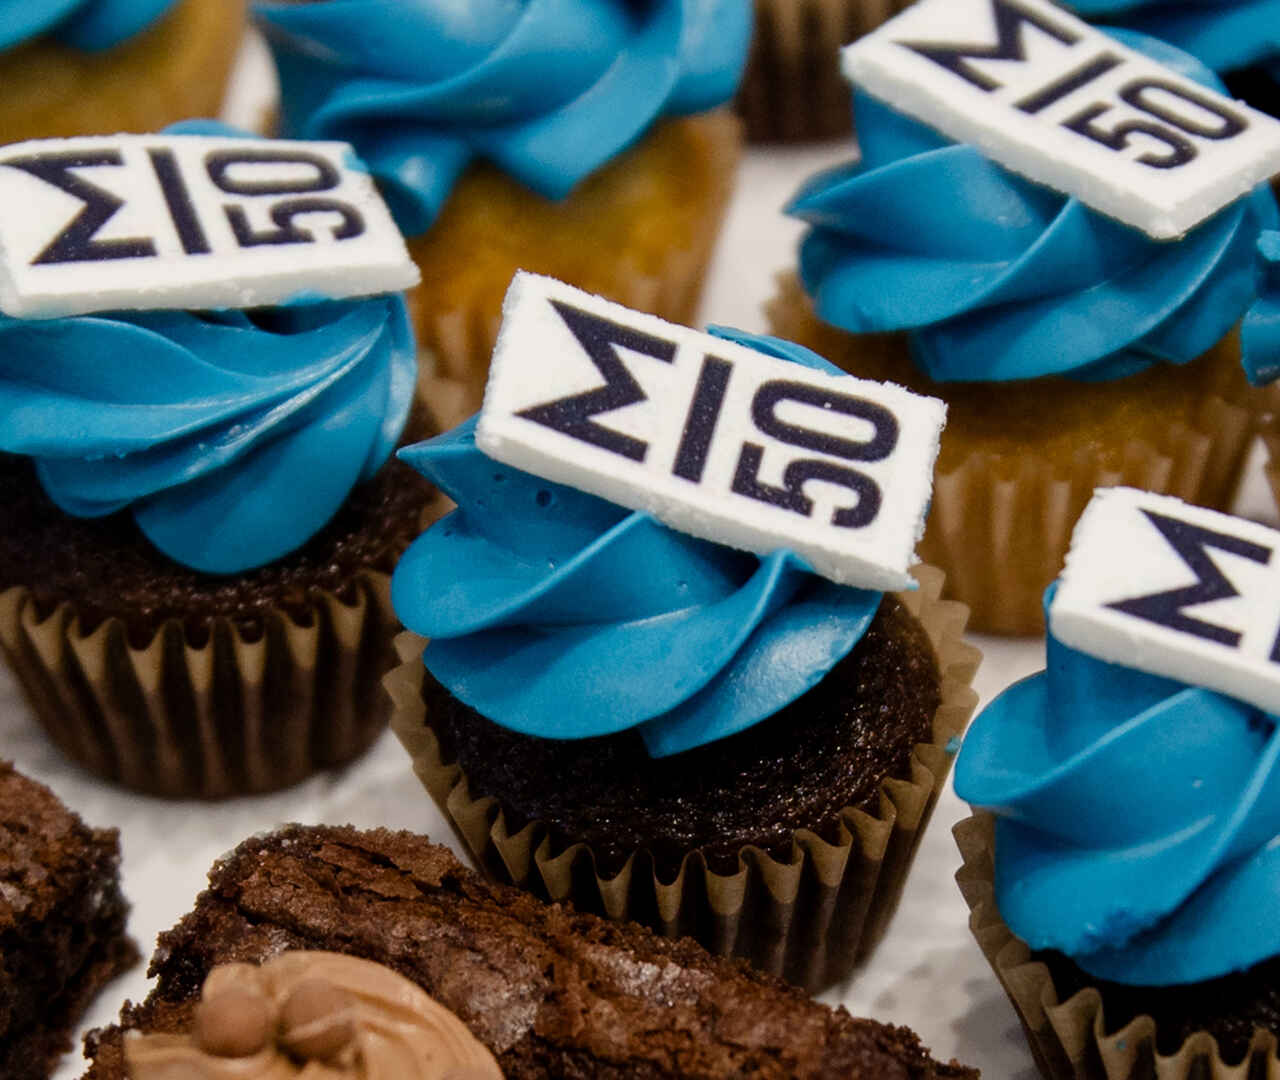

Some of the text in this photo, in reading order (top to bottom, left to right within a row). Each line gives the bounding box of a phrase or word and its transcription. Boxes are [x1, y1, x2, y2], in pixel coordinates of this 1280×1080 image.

[1060, 76, 1250, 171] 50
[206, 151, 366, 249] 50
[731, 380, 899, 528] 50
